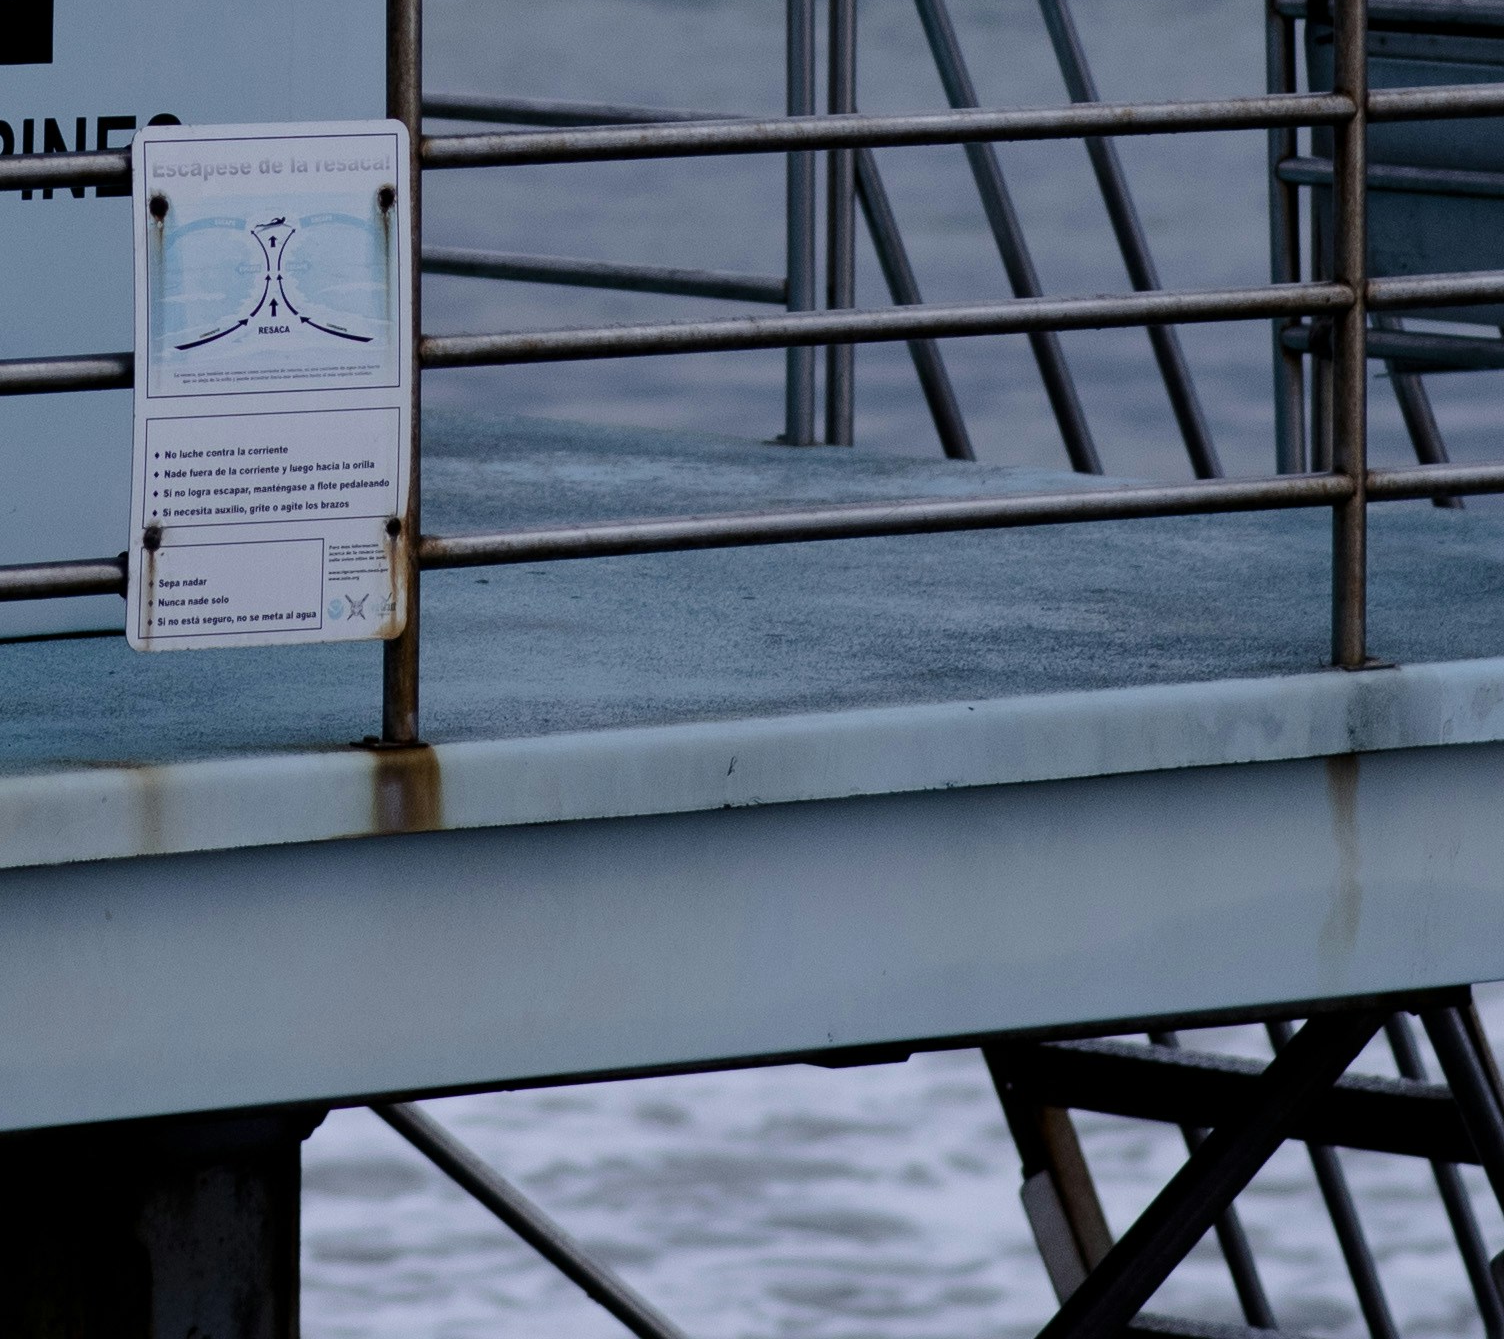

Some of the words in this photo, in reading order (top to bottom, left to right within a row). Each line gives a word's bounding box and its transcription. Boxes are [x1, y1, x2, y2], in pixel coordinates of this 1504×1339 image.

[259, 160, 282, 174] de
[291, 159, 308, 173] la
[258, 325, 291, 335] RESACA
[164, 450, 177, 460] No
[179, 449, 204, 459] luche
[205, 448, 235, 458] contra
[237, 447, 246, 456] la
[247, 445, 289, 456] corriente
[163, 469, 188, 479] Nade
[189, 468, 213, 478] fuera
[214, 467, 227, 477] de
[228, 467, 237, 476] la
[239, 465, 280, 476] corriente
[282, 466, 288, 476] y
[289, 463, 314, 475] luego
[315, 462, 340, 471] hacia
[342, 461, 351, 470] la
[352, 460, 375, 470] orilla
[174, 490, 186, 498] no
[187, 487, 211, 499] logra
[213, 487, 251, 497] escapar,
[253, 483, 308, 494] manténgase
[309, 483, 315, 491] a
[317, 481, 338, 491] flote
[339, 478, 390, 492] pedaleando
[173, 506, 213, 517] necesita
[214, 504, 248, 515] auxilio,
[272, 504, 279, 512] o
[280, 501, 304, 514] agite
[305, 500, 319, 510] los
[320, 500, 350, 509] brazos
[158, 578, 181, 590] Sepa
[182, 577, 208, 587] nadar
[158, 598, 186, 607] Nunca
[187, 596, 210, 606] nade
[211, 595, 230, 605] solo
[157, 617, 166, 627] Si
[167, 618, 179, 626] no
[180, 616, 200, 626] está
[202, 615, 235, 626] seguro,
[236, 614, 248, 623] no
[249, 614, 260, 622] se
[261, 611, 284, 621] meta
[285, 610, 294, 620] al
[295, 611, 317, 621] agua
